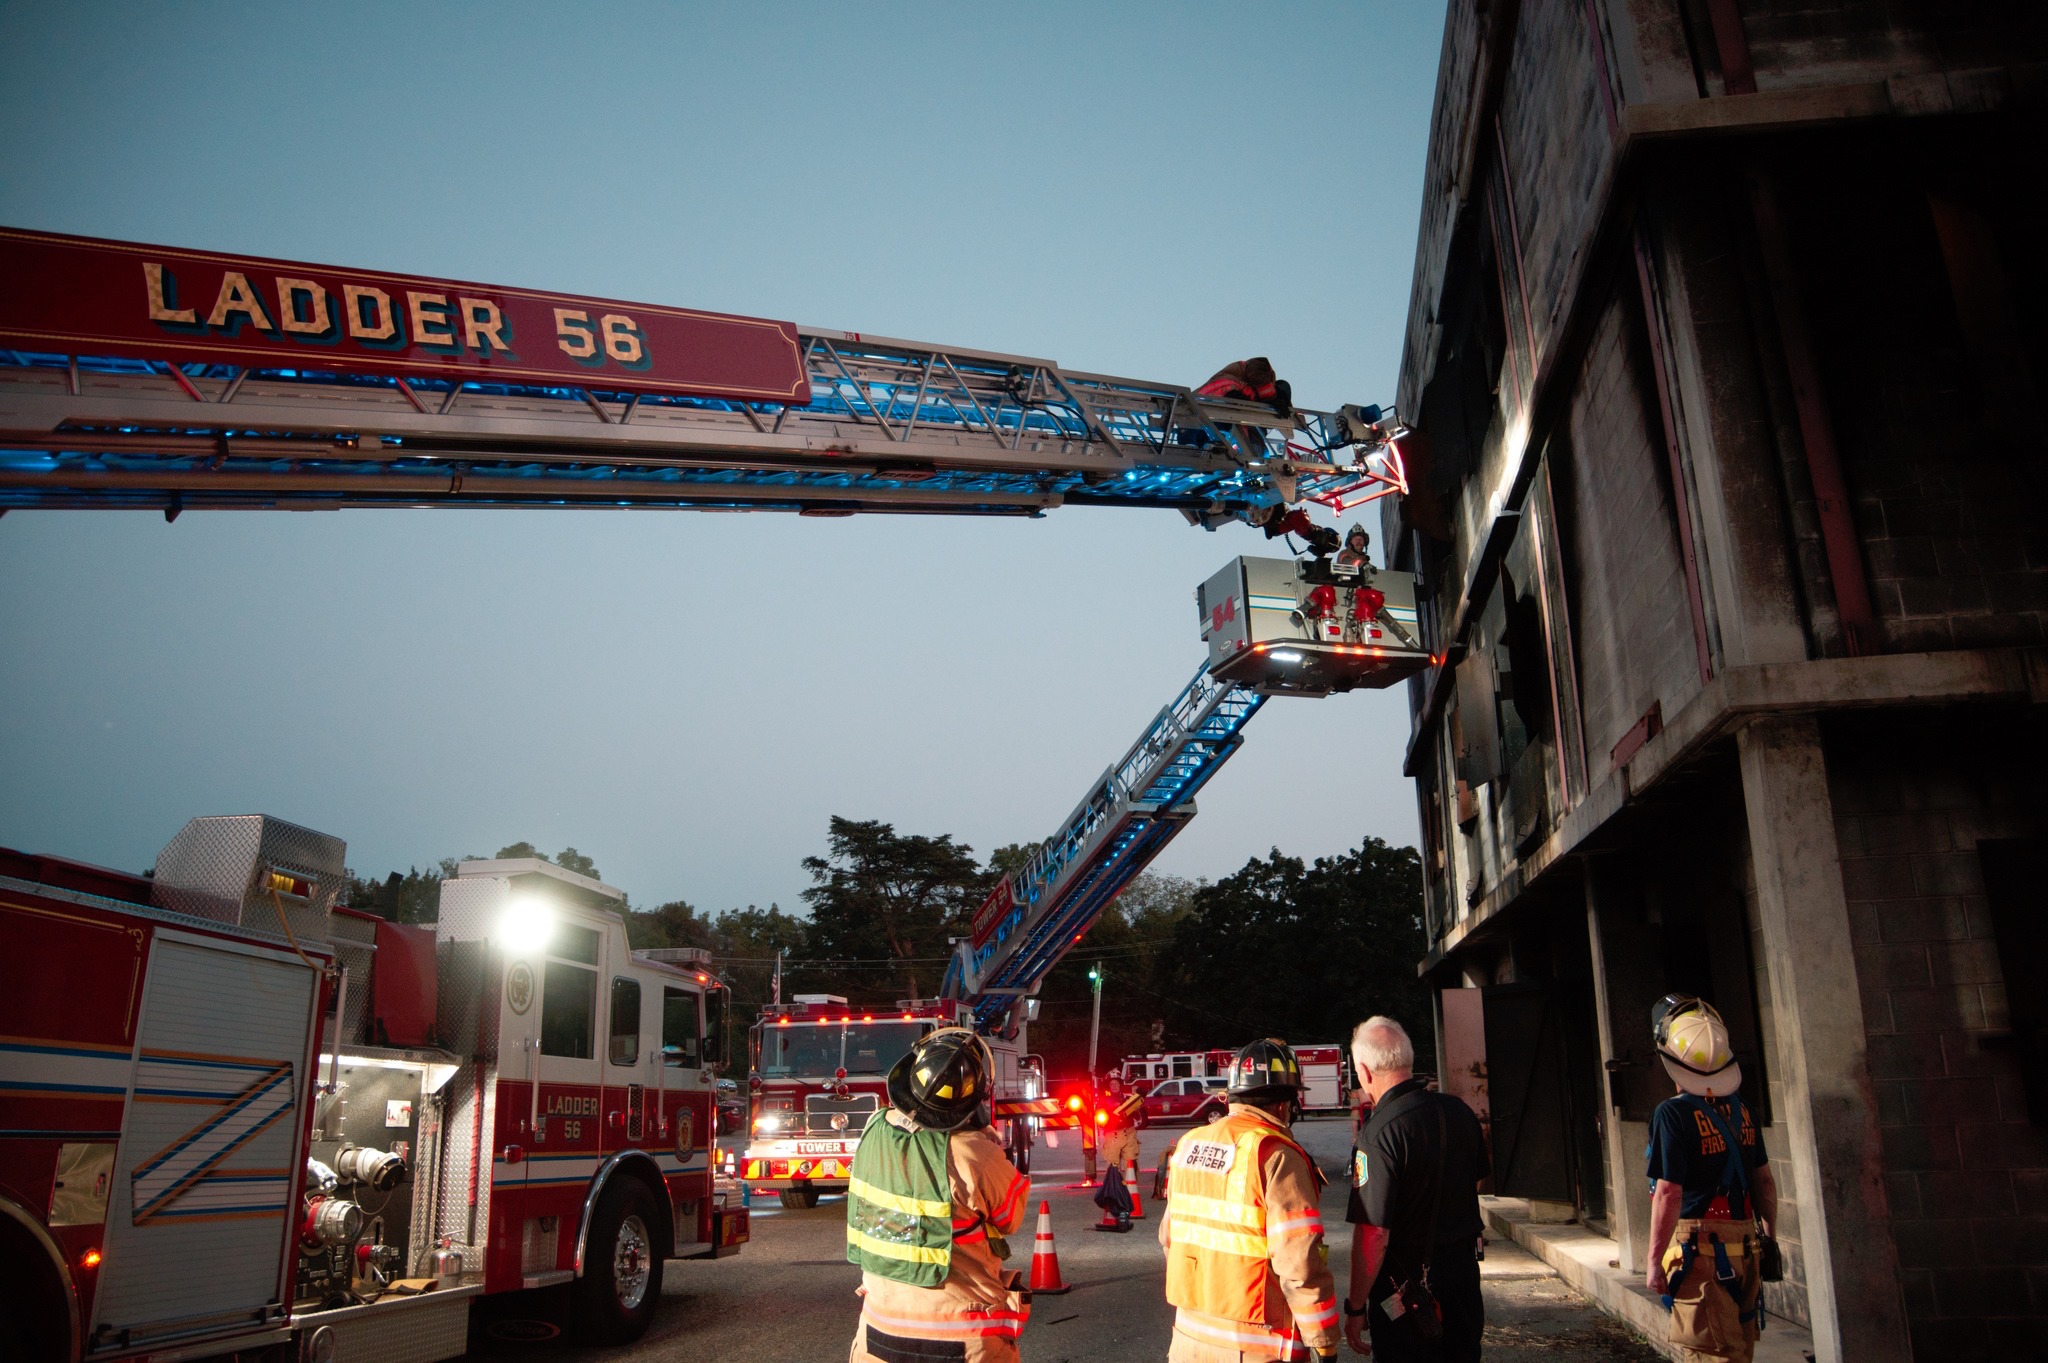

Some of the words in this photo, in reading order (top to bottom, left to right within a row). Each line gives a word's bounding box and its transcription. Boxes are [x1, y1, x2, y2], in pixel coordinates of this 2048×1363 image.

[142, 262, 508, 351] LADDER
[553, 307, 642, 362] 56
[843, 331, 854, 341] 75
[1212, 595, 1235, 632] 54
[547, 1095, 598, 1116] LADDER
[564, 1120, 580, 1139] 56
[799, 1142, 841, 1152] TOWER
[1192, 1144, 1228, 1159] SAFETY
[1701, 1134, 1726, 1155] FIRE
[1186, 1154, 1226, 1170] OFFICER
